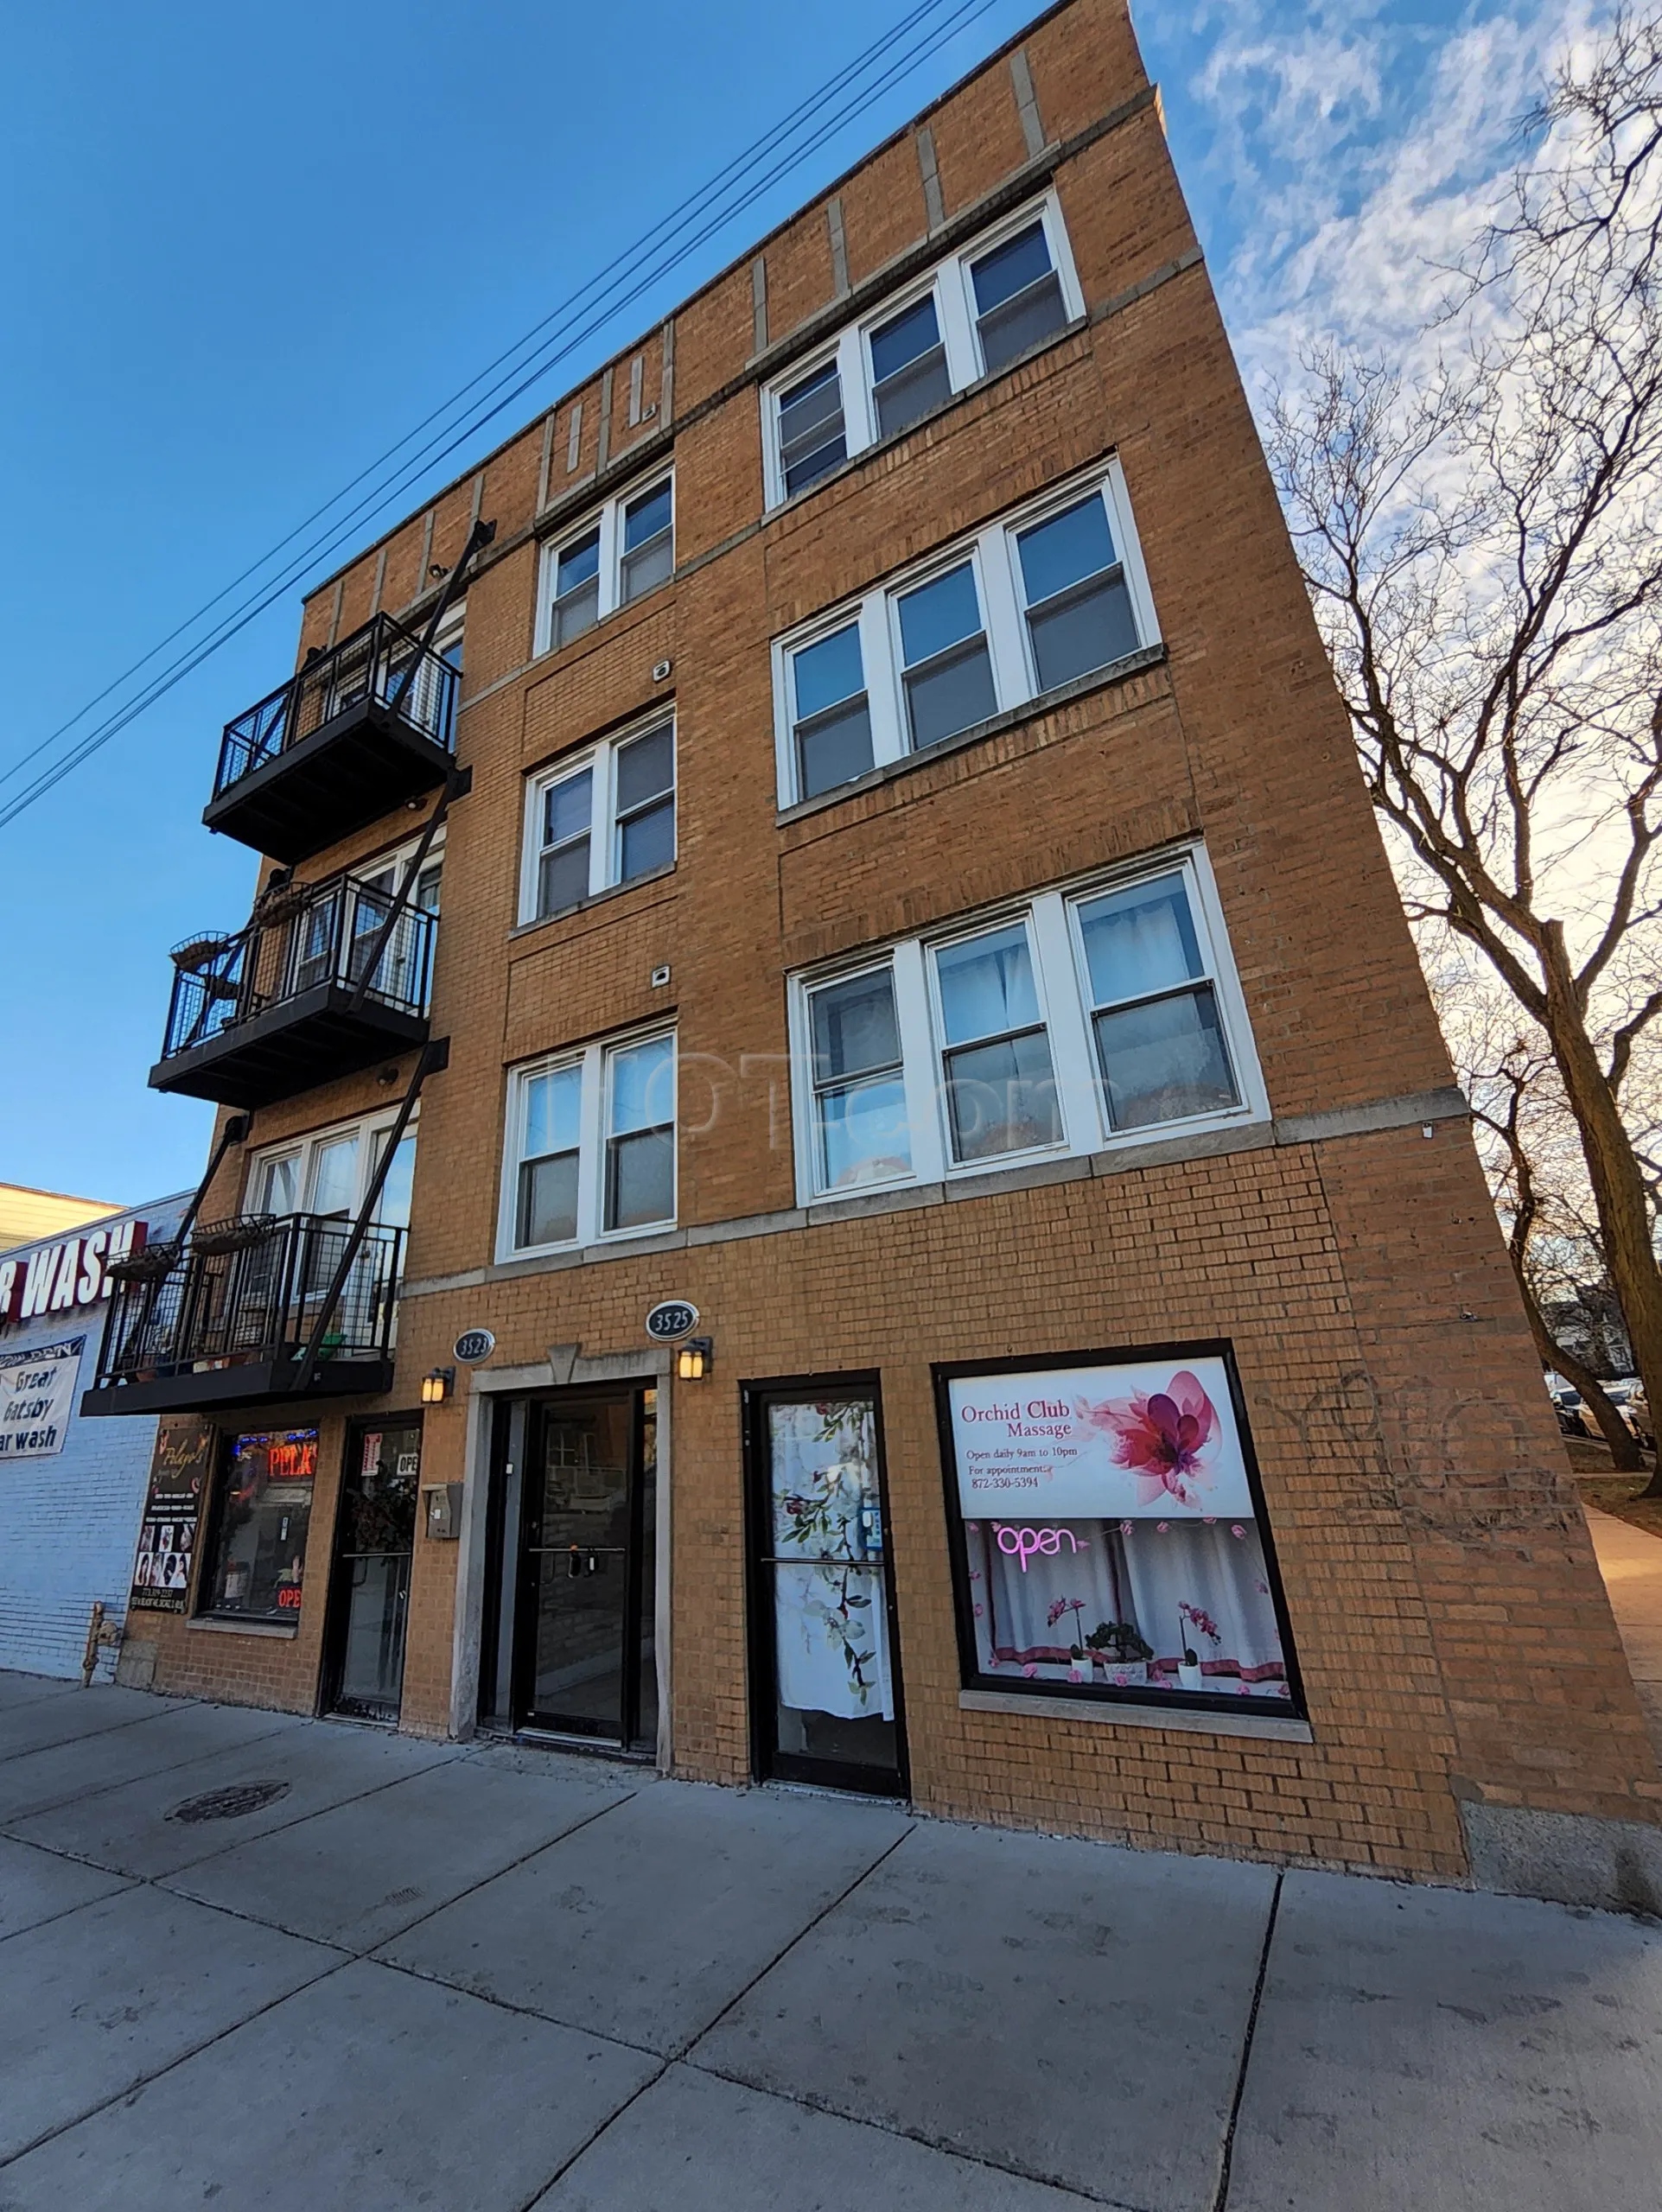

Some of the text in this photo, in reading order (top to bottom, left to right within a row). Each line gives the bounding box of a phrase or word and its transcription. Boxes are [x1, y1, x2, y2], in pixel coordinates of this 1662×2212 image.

[20, 1220, 136, 1319] WASH
[655, 1310, 689, 1332] 3525
[461, 1337, 487, 1356] 3523
[15, 1365, 58, 1394] Great
[3, 1396, 54, 1422] Gatsby
[961, 1399, 1070, 1423] Orchid Club
[16, 1424, 57, 1451] wash
[1007, 1421, 1072, 1440] Massage
[399, 1456, 418, 1472] OPE
[965, 1449, 991, 1462] Open
[993, 1448, 1015, 1460] daily
[1016, 1447, 1036, 1458] 9am
[1052, 1446, 1078, 1458] 10pm
[968, 1465, 984, 1476] For
[997, 1527, 1077, 1573] open
[278, 1589, 301, 1608] OPE
